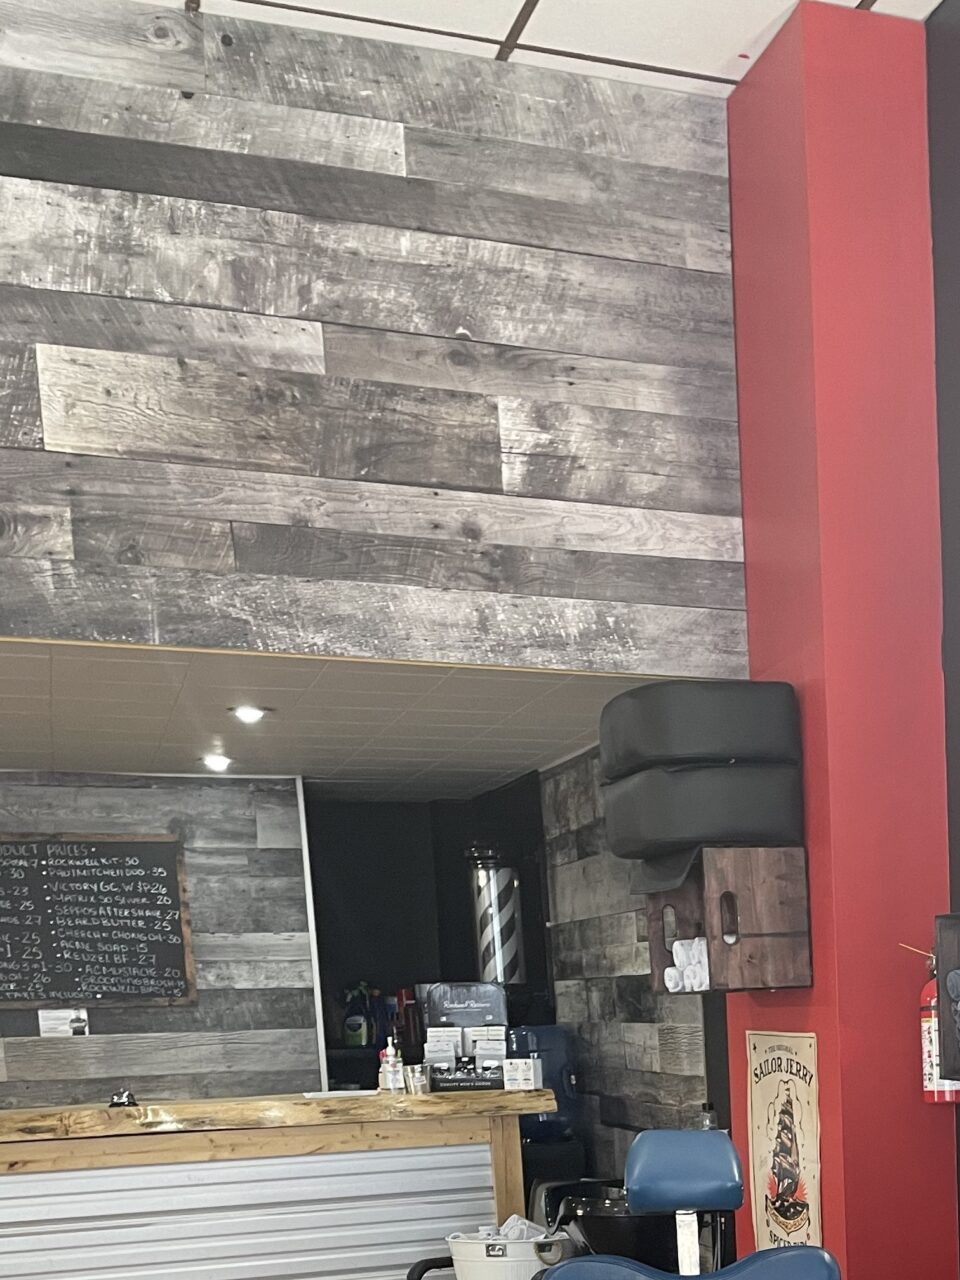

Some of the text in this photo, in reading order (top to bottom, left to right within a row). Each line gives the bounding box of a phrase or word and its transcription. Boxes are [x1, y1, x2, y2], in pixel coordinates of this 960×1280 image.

[47, 844, 89, 857] PRICES
[48, 881, 98, 893] VICTORY
[753, 1056, 814, 1087] SAILOR JERRY
